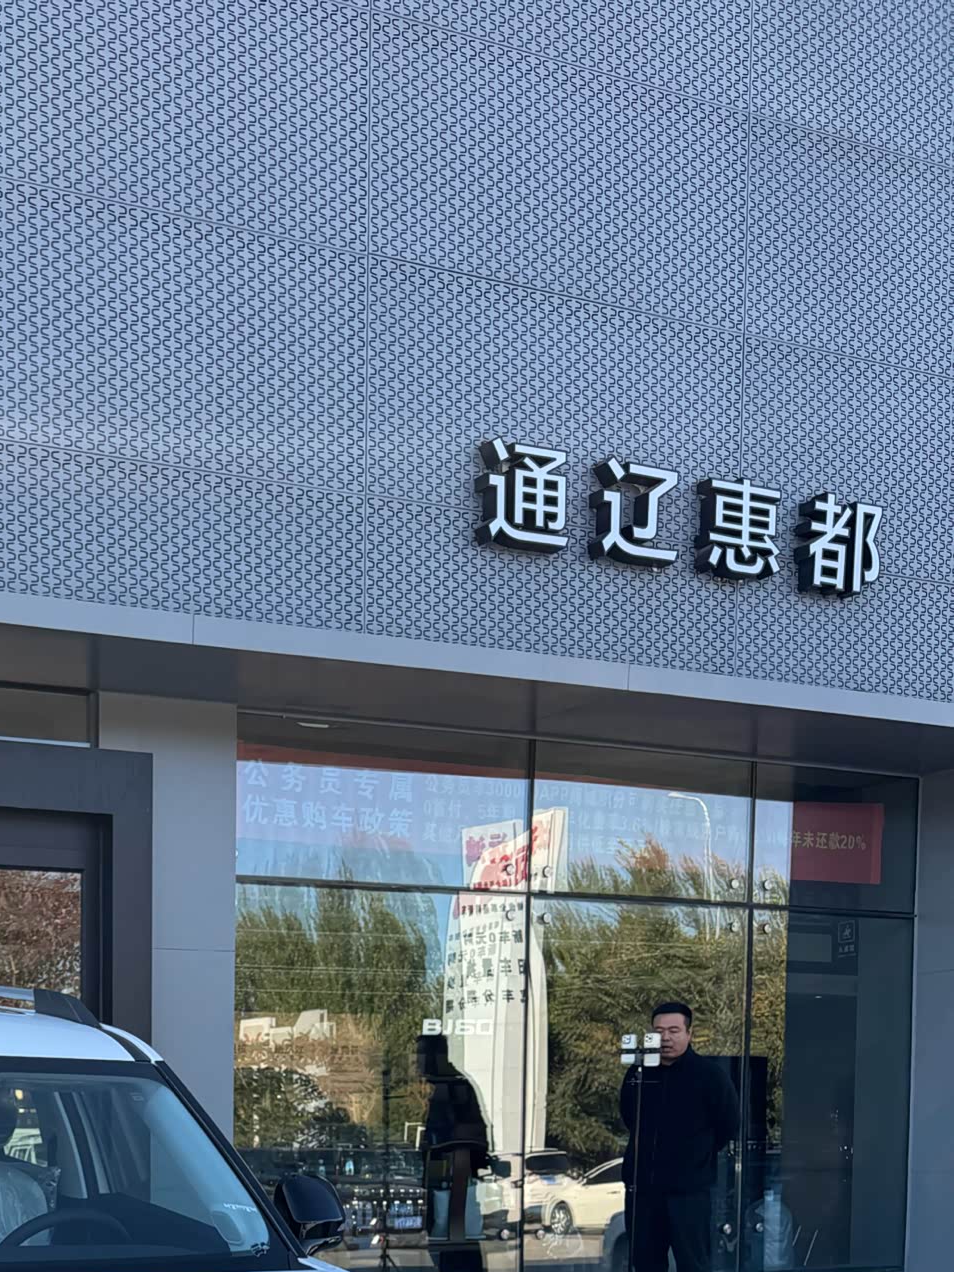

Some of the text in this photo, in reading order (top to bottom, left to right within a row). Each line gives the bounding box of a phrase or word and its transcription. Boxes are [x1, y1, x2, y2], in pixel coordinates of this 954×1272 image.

[480, 437, 884, 597] 通辽惠都
[243, 760, 414, 801] 公务员专属
[242, 795, 414, 838] 优惠购车政策
